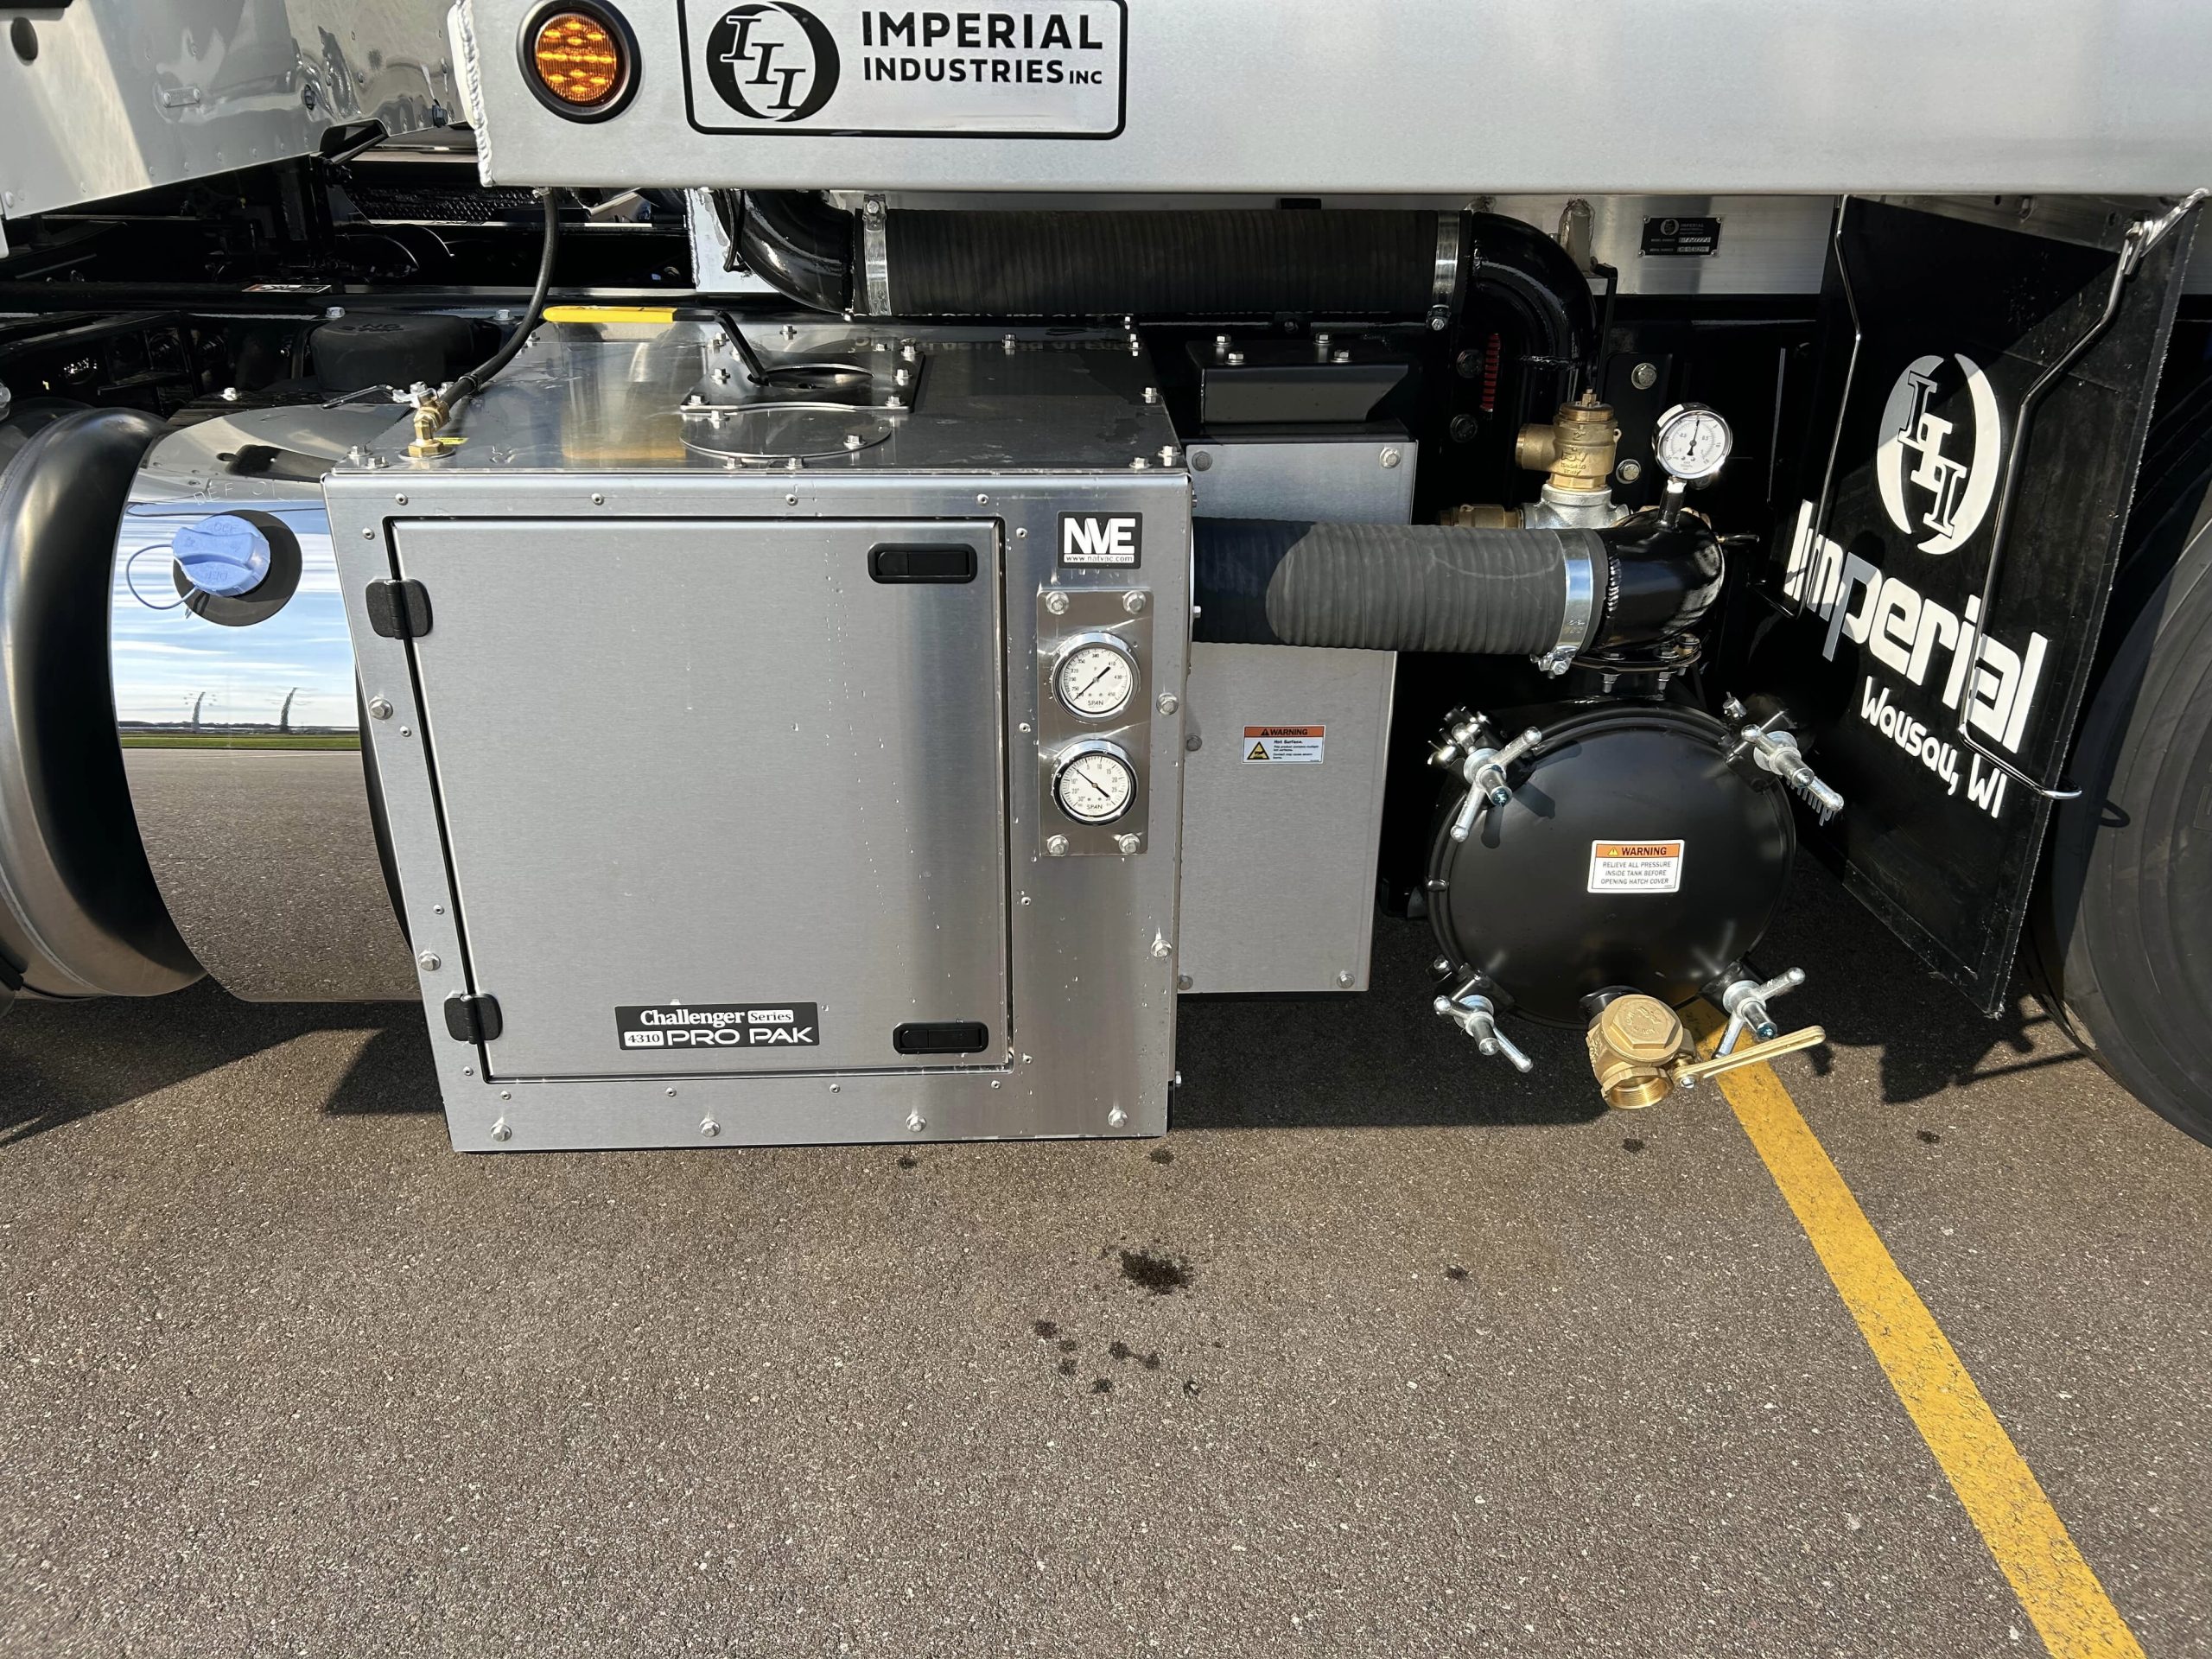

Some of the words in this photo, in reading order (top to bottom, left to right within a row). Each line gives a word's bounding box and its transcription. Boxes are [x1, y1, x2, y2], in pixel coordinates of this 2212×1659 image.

[861, 11, 1103, 50] IMPERIAL
[863, 57, 1064, 85] INDUSTRIES
[1069, 69, 1103, 85] INC
[1064, 518, 1135, 554] NVE
[1783, 499, 2049, 753] Imperial
[1861, 676, 1958, 796] Wausau,
[1967, 753, 2007, 819] WI
[1622, 847, 1667, 855] WARNING
[640, 1009, 746, 1027] Challenger
[750, 1012, 791, 1022] Series
[627, 1034, 660, 1044] 4310
[667, 1029, 740, 1046] PRO
[749, 1027, 813, 1044] PAK
